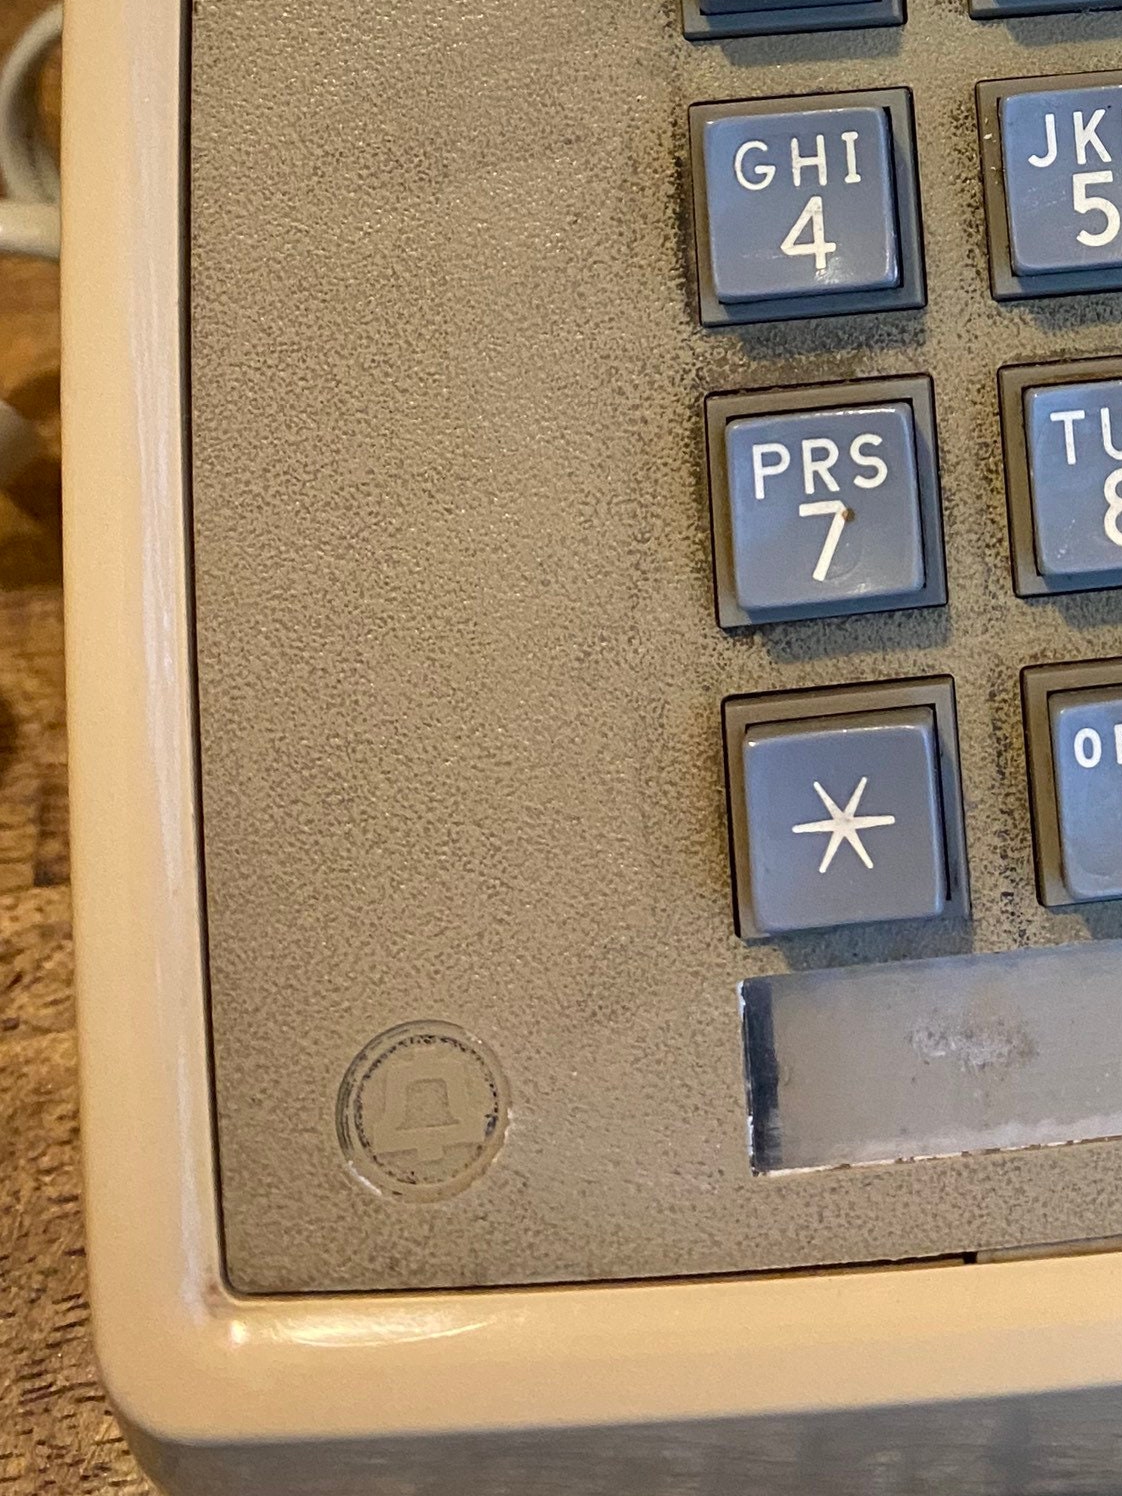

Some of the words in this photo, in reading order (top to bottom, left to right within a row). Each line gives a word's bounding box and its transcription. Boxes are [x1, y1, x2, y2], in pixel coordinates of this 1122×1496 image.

[734, 131, 862, 191] GHI
[779, 195, 842, 273] 4
[1072, 169, 1121, 247] 5
[751, 433, 888, 500] PRS
[798, 499, 853, 583] 7
